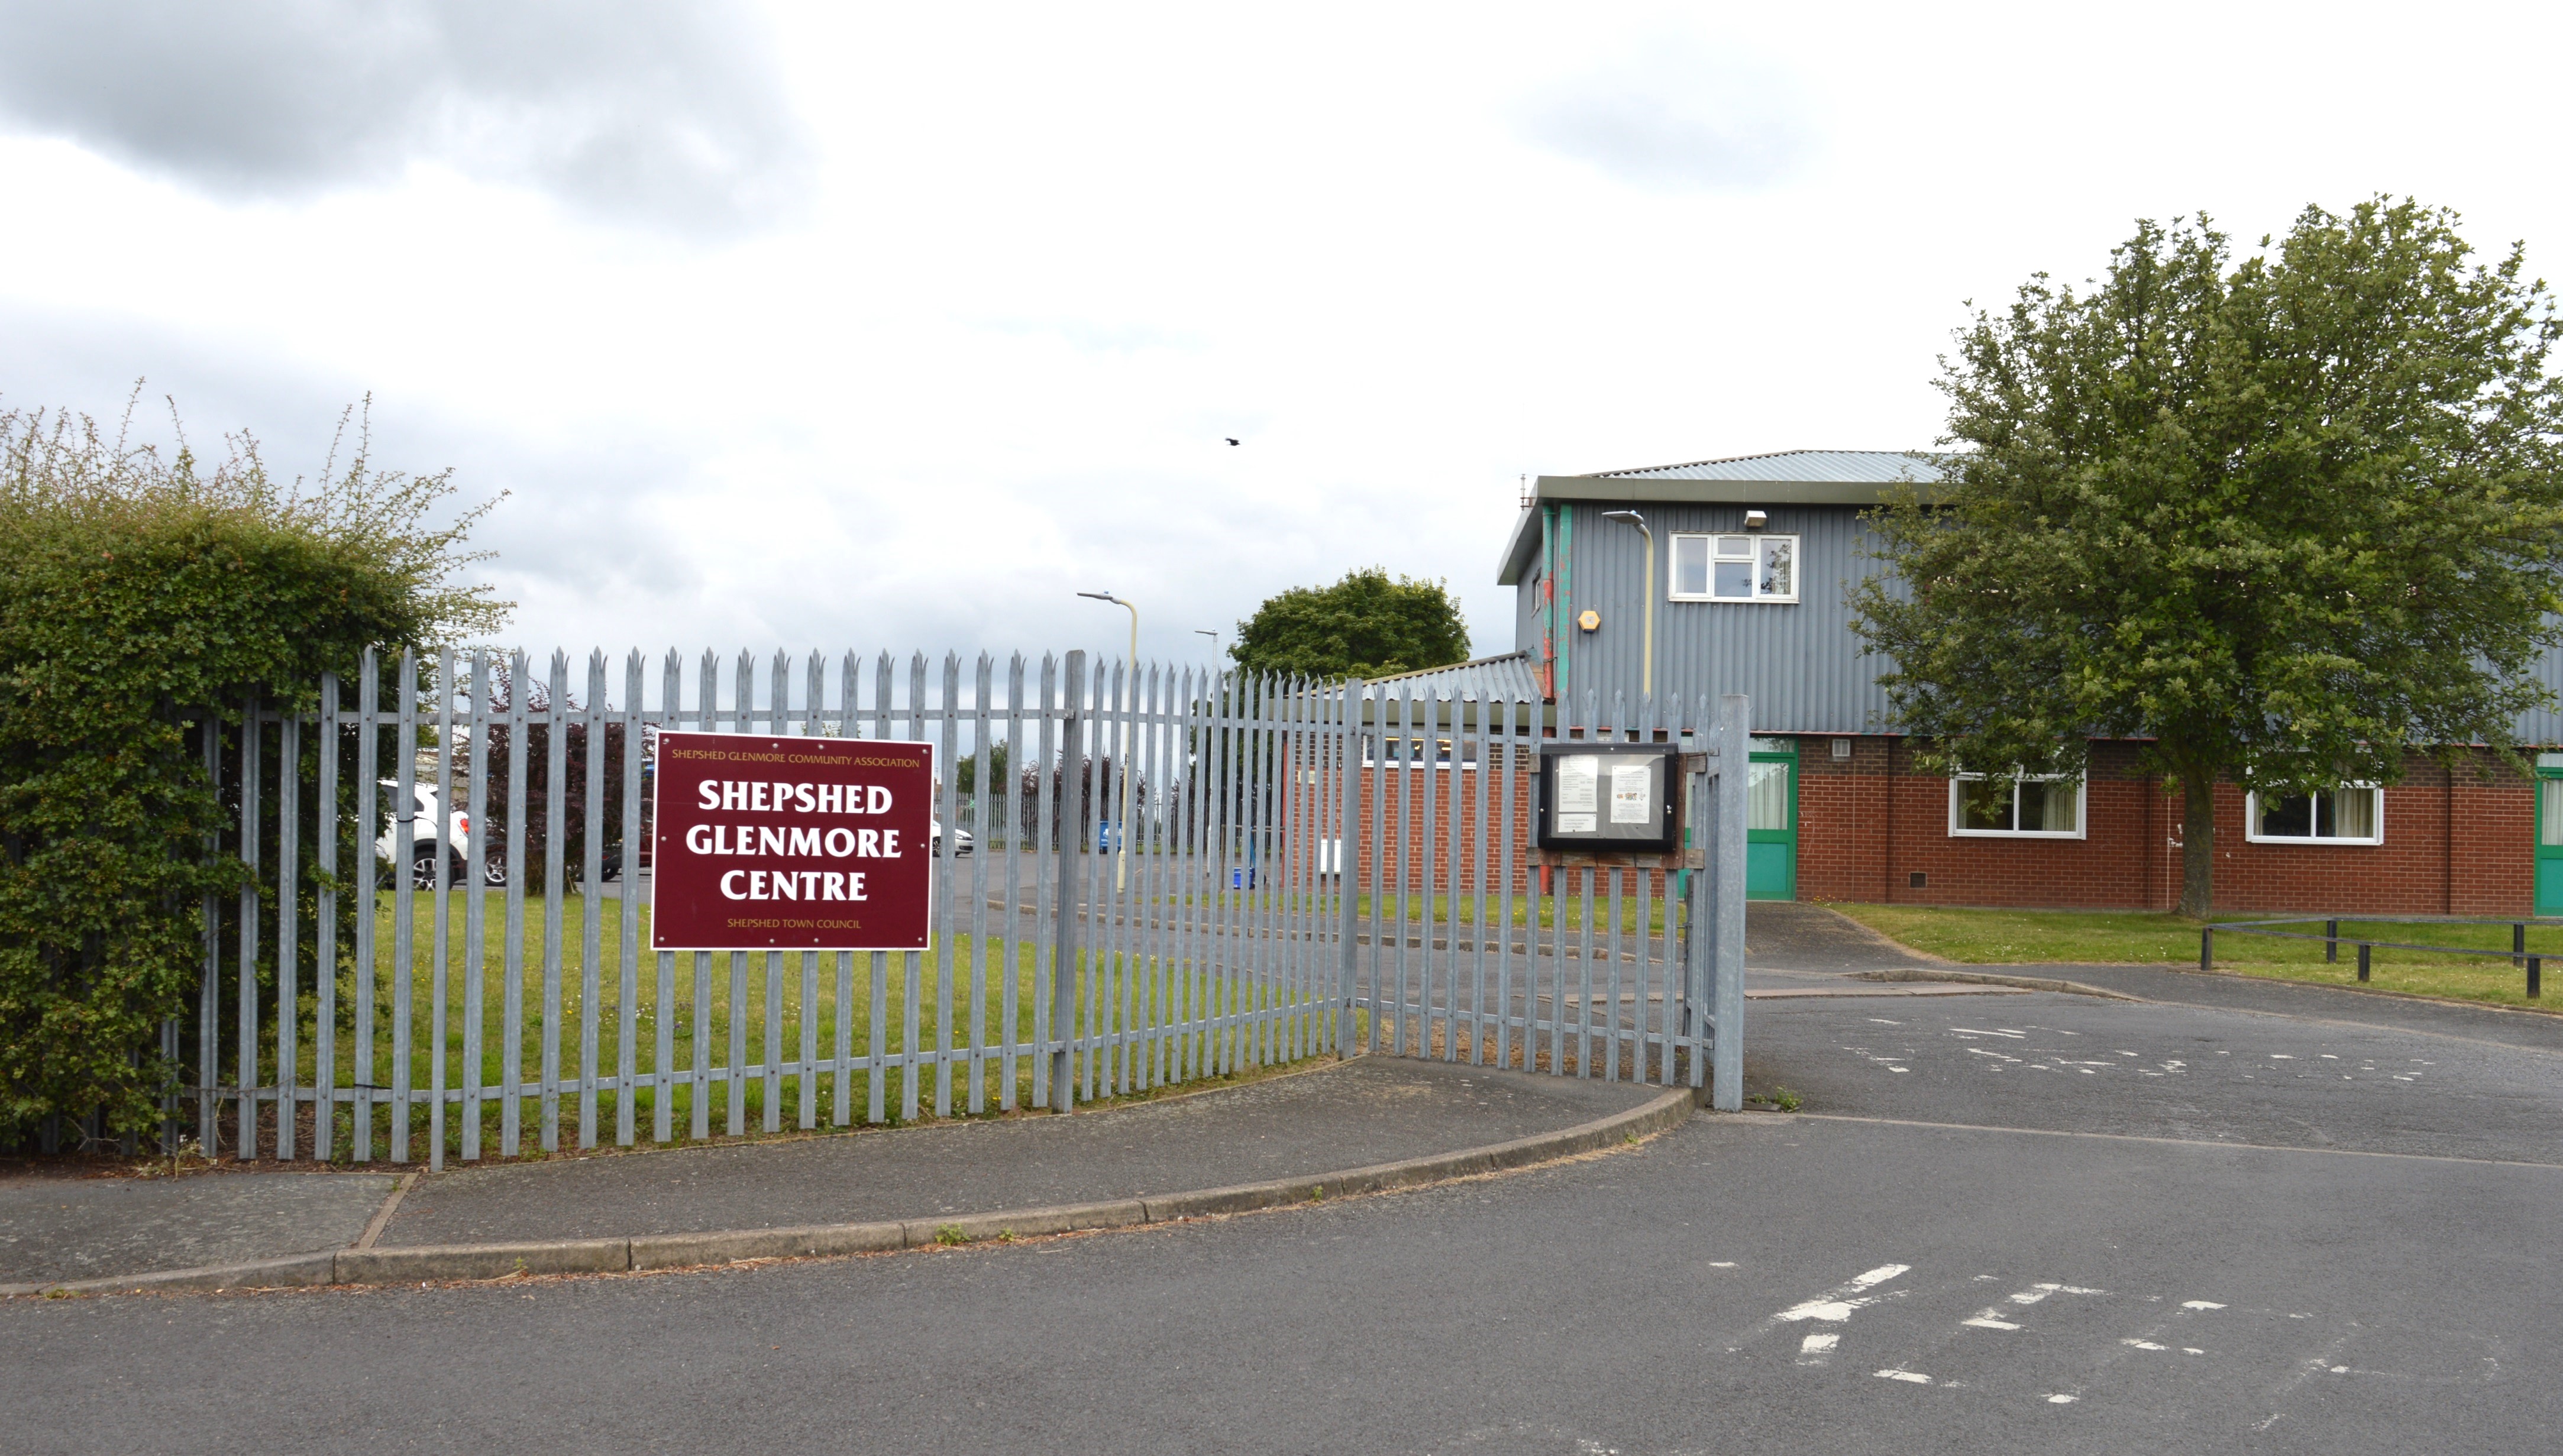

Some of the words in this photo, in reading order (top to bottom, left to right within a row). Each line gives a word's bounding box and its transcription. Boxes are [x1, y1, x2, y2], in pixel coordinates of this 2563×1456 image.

[672, 749, 726, 761] SHEPSHED
[728, 751, 786, 763] GLENMORE
[788, 754, 852, 765] COMMUNITY
[854, 756, 920, 768] ASSOCIATION
[699, 779, 893, 814] SHEPSHED
[686, 824, 902, 858] GLENMORE
[720, 870, 868, 901] CENTRE
[728, 918, 780, 928] SHEPSHED
[783, 919, 814, 928] TOWN
[817, 919, 861, 929] COUNCIL
